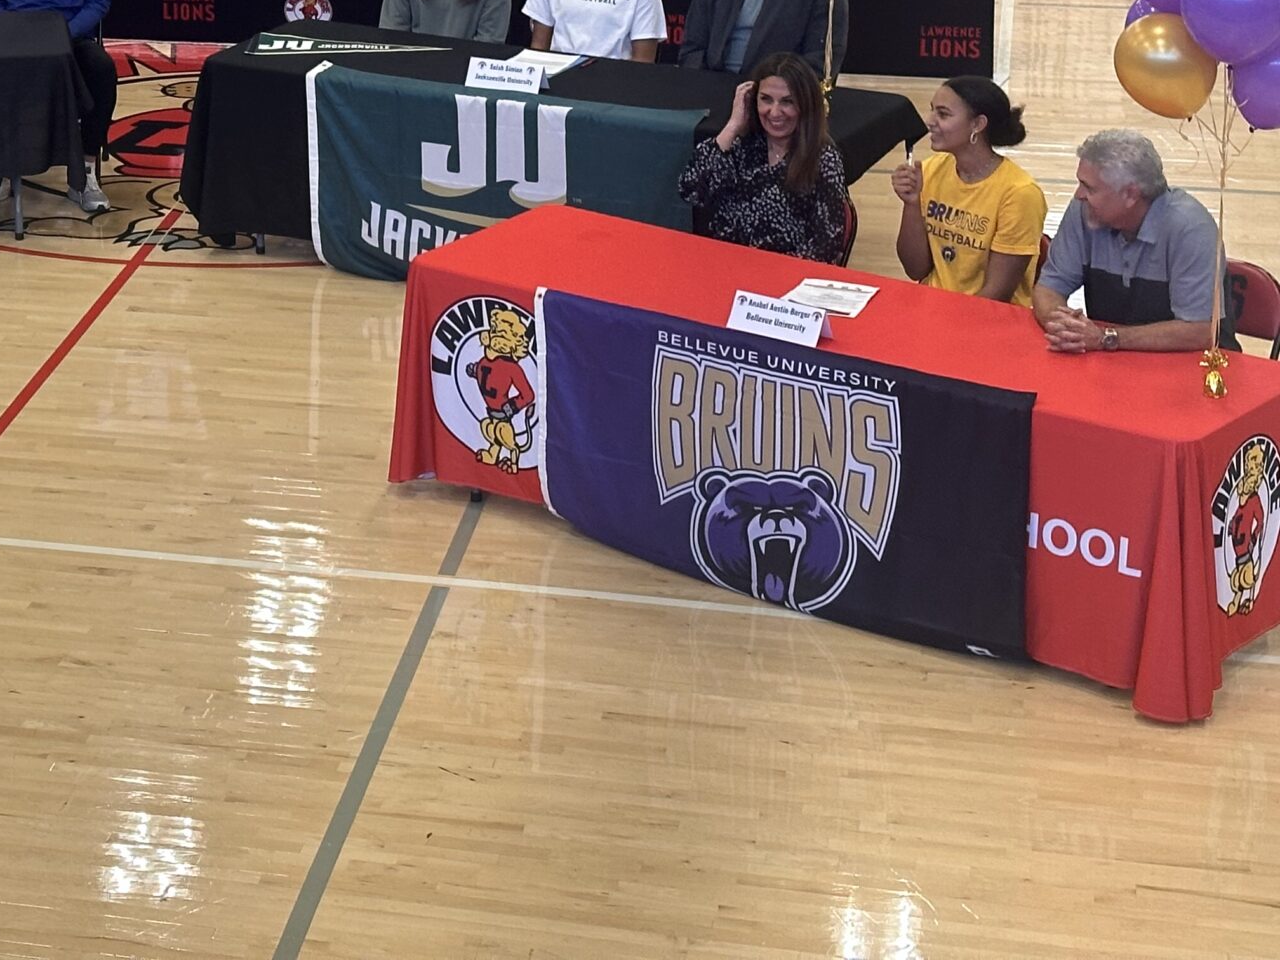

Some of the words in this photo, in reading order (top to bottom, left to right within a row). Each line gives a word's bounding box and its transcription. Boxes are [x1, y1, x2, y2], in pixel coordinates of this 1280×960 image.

[163, 3, 216, 22] LIONS
[921, 25, 982, 39] LAWRENCE
[920, 39, 981, 58] LIONS
[421, 93, 573, 208] JU
[361, 201, 469, 262] JACK
[926, 200, 990, 235] BRUINS
[926, 223, 986, 251] OLLEYBALL
[745, 312, 772, 325] Bellevue
[773, 316, 806, 334] University
[658, 330, 759, 365] BELLEVUE
[767, 355, 896, 392] UNIVERSITY
[654, 347, 900, 552] BRUINS
